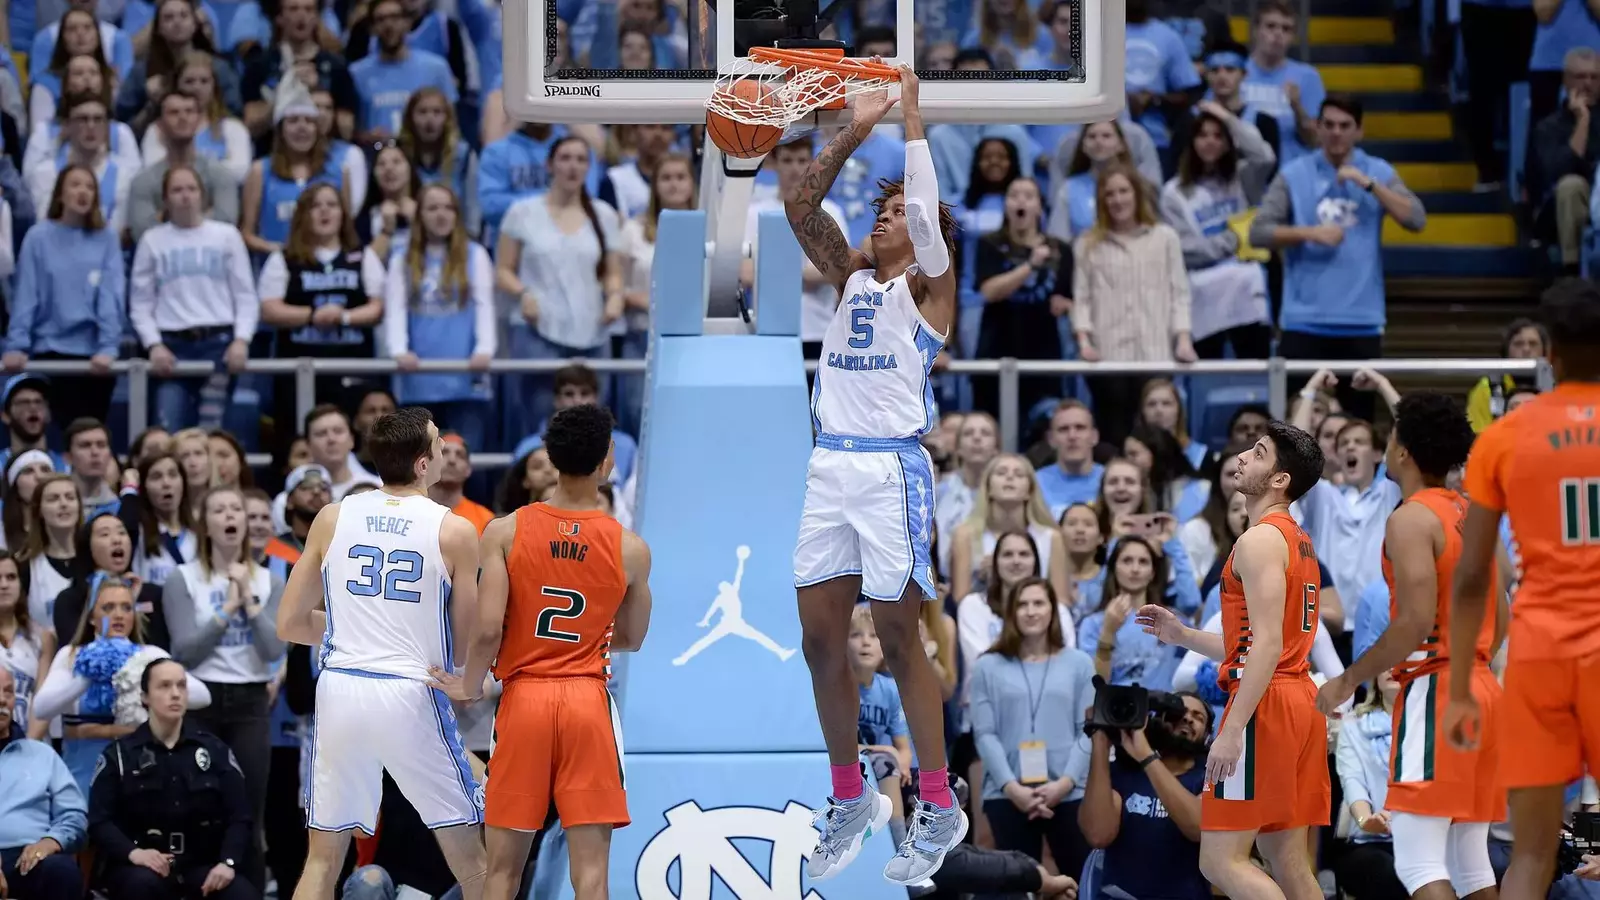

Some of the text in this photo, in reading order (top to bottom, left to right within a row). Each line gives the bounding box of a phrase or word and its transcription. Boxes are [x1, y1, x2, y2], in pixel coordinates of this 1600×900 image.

[544, 84, 601, 98] SPALDING
[847, 308, 876, 349] 5
[827, 352, 898, 371] CAROLINA
[365, 515, 414, 537] PIERCE
[549, 540, 589, 562] WONG
[346, 544, 424, 604] 32
[534, 585, 587, 643] 2
